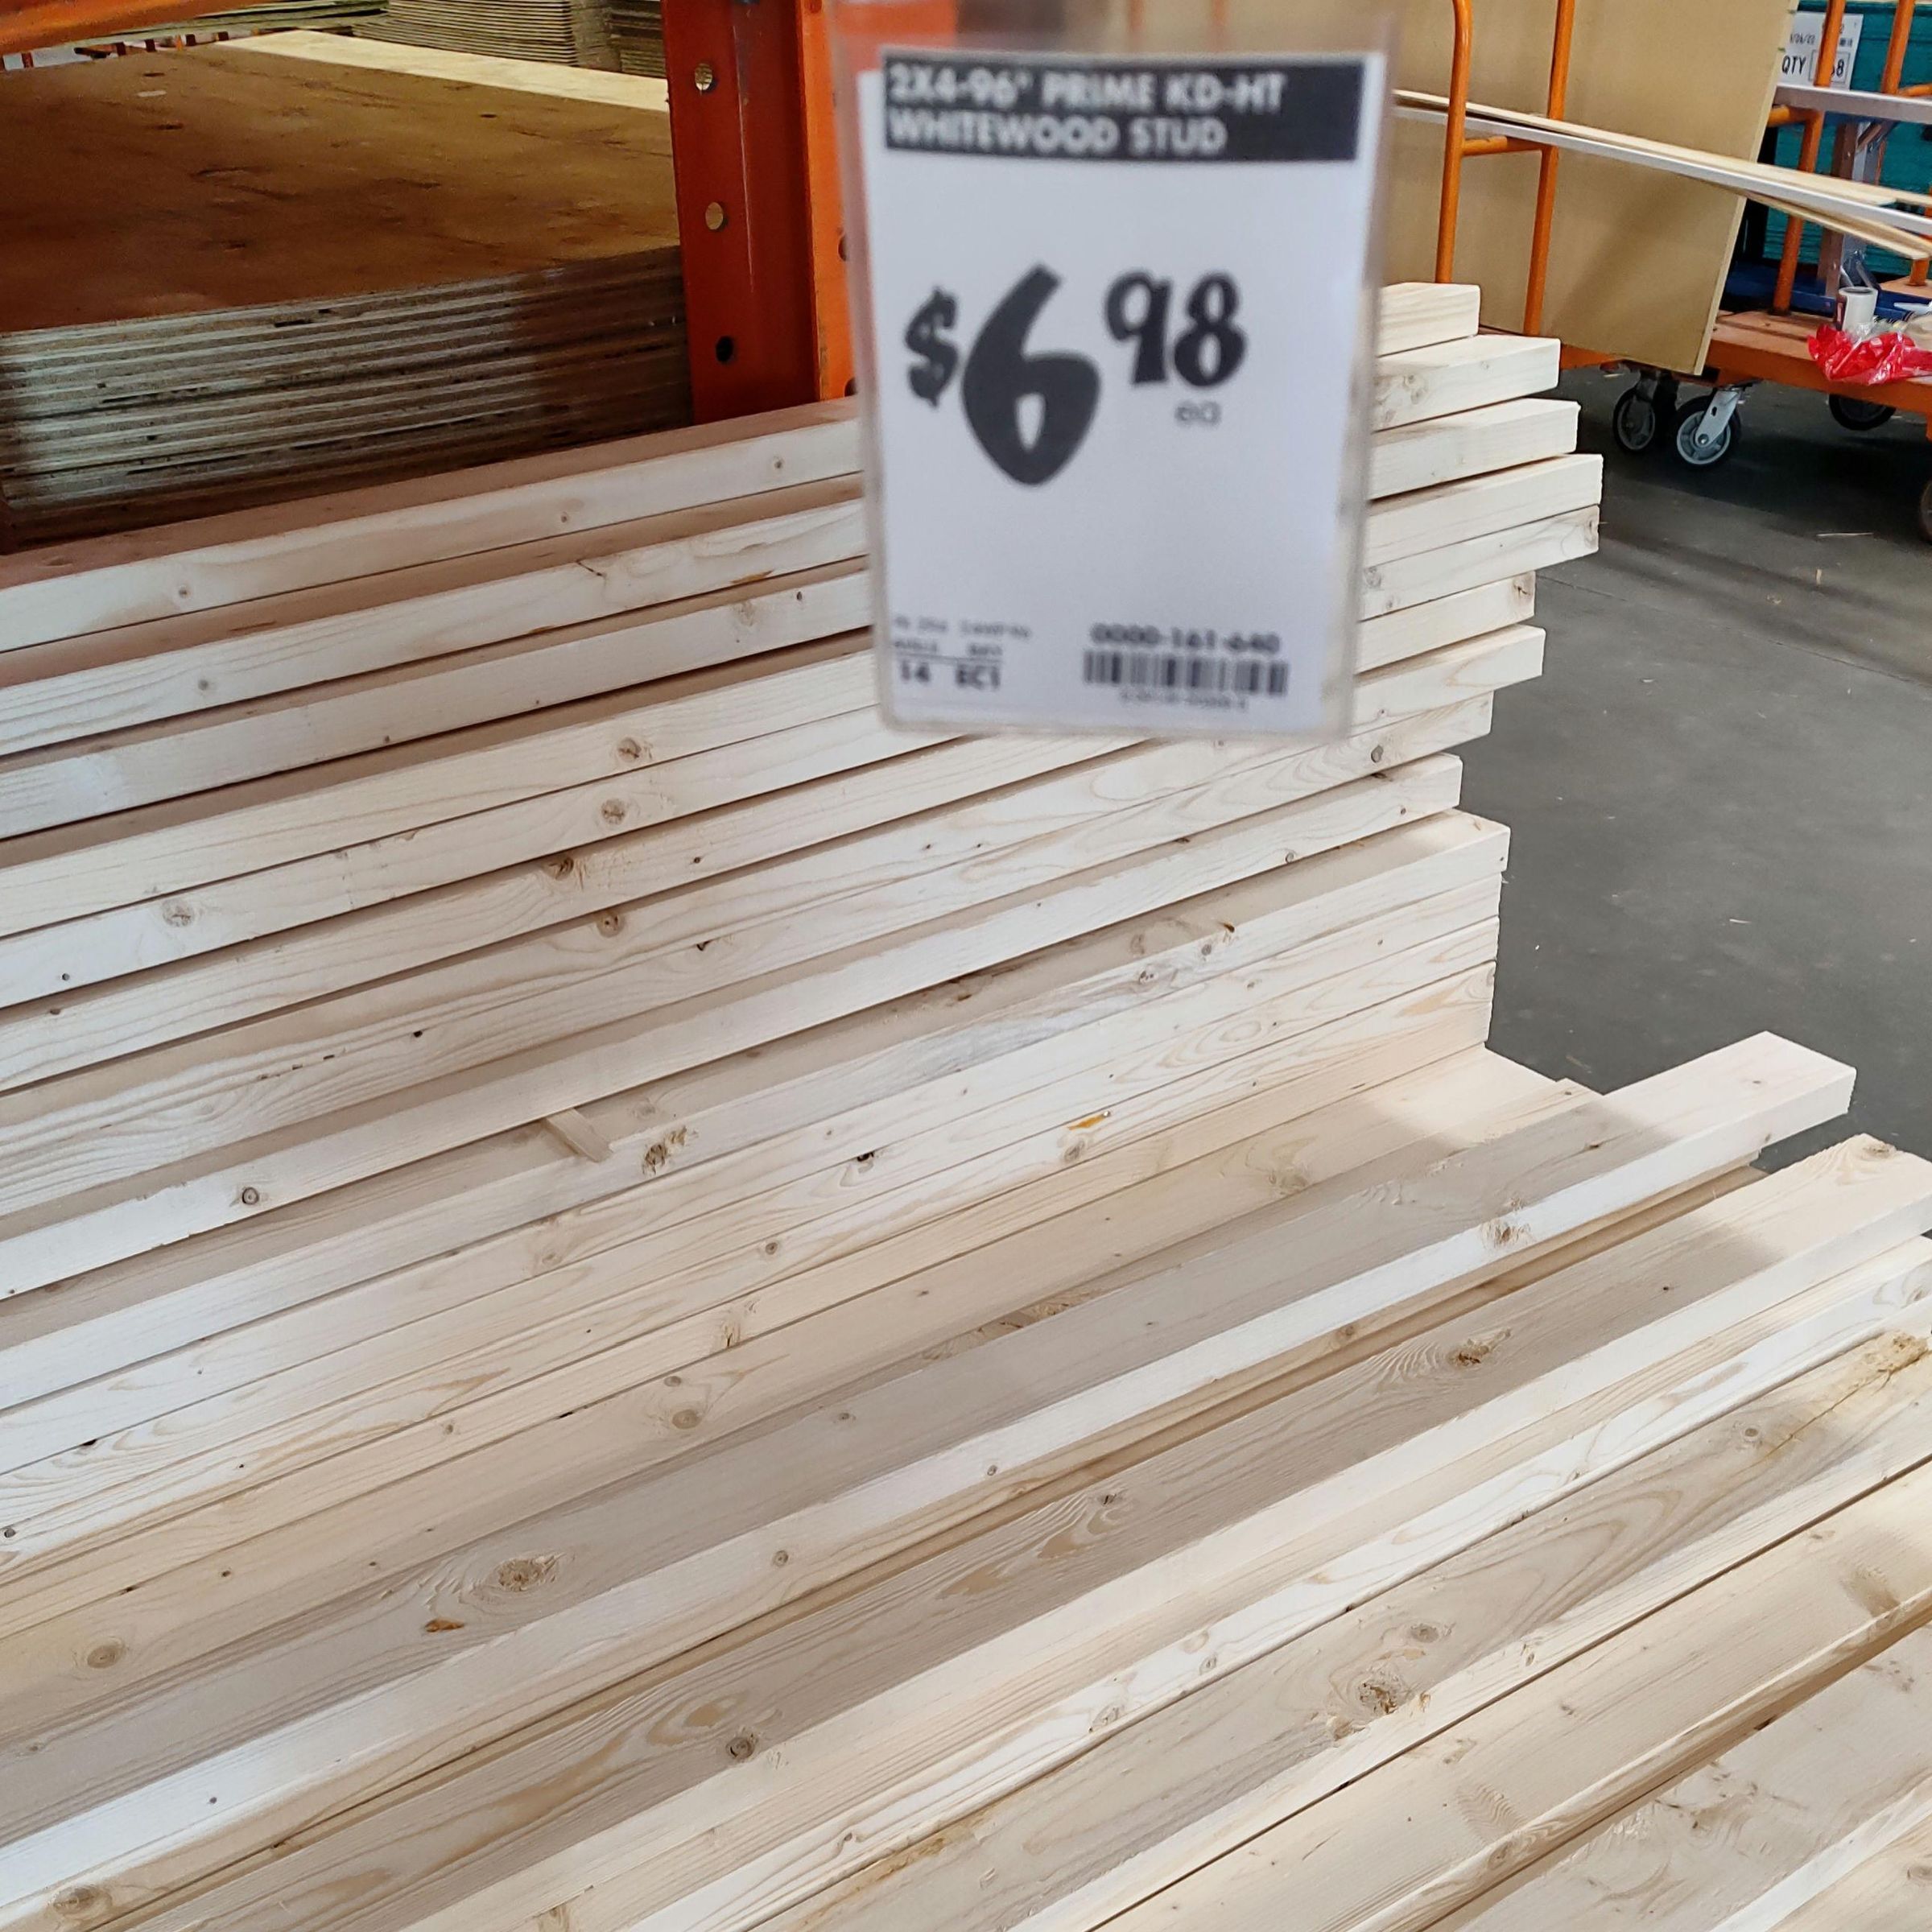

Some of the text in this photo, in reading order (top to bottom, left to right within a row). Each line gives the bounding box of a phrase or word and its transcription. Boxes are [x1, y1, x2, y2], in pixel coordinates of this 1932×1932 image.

[889, 63, 1288, 116] 2X4-96" PRIME KD-HT
[1781, 55, 1806, 76] QTY
[889, 106, 1228, 156] WHITEWOOD STUD
